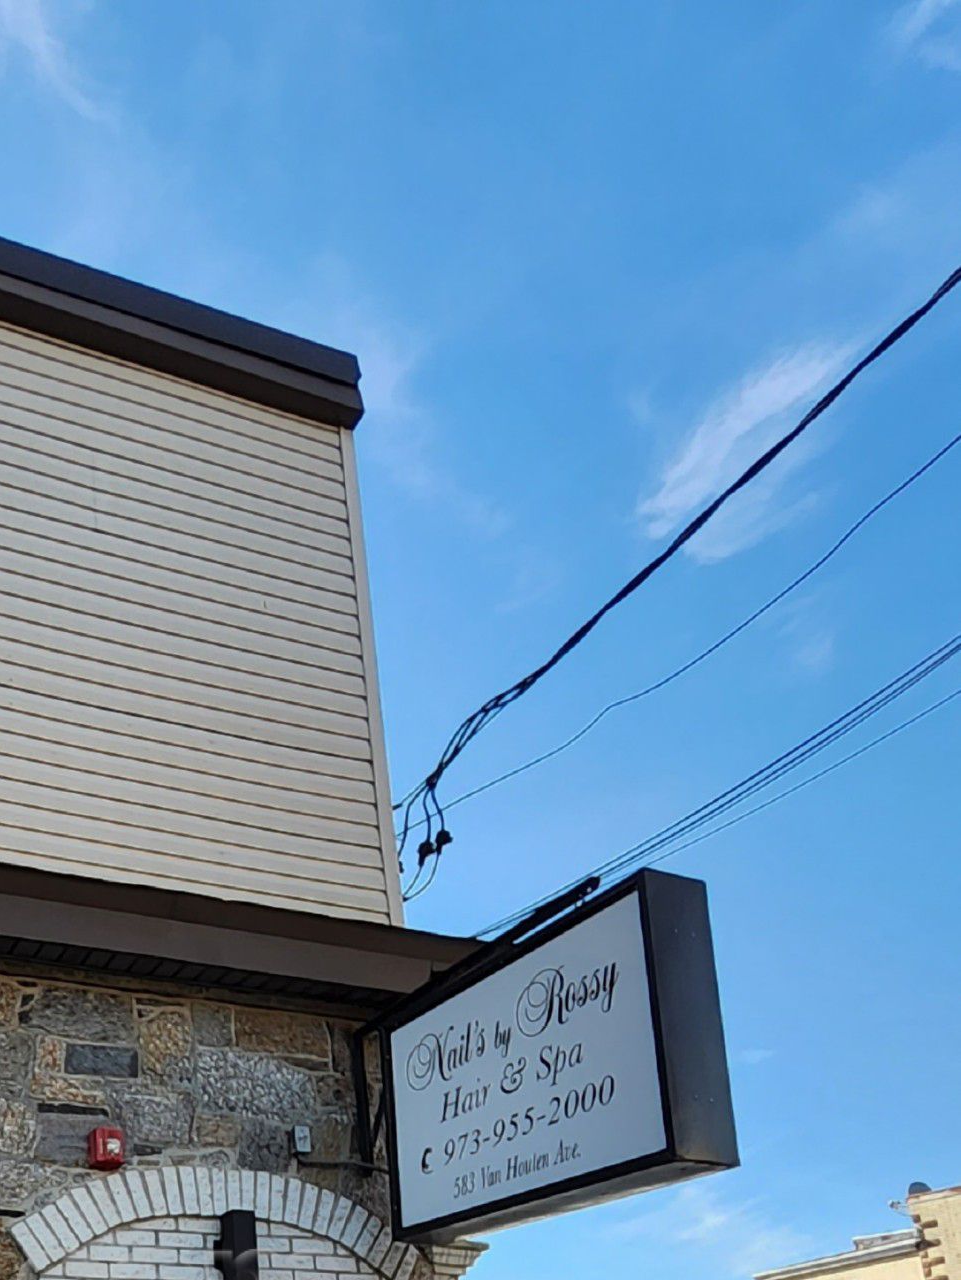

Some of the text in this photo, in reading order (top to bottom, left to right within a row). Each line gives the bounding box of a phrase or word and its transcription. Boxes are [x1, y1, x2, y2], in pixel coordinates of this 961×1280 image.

[494, 1020, 512, 1058] by
[516, 962, 620, 1038] Rossy
[440, 1042, 584, 1124] Hair & Spa
[443, 1074, 616, 1167] 973-955-2000
[453, 1171, 475, 1199] 583
[480, 1165, 502, 1189] Van
